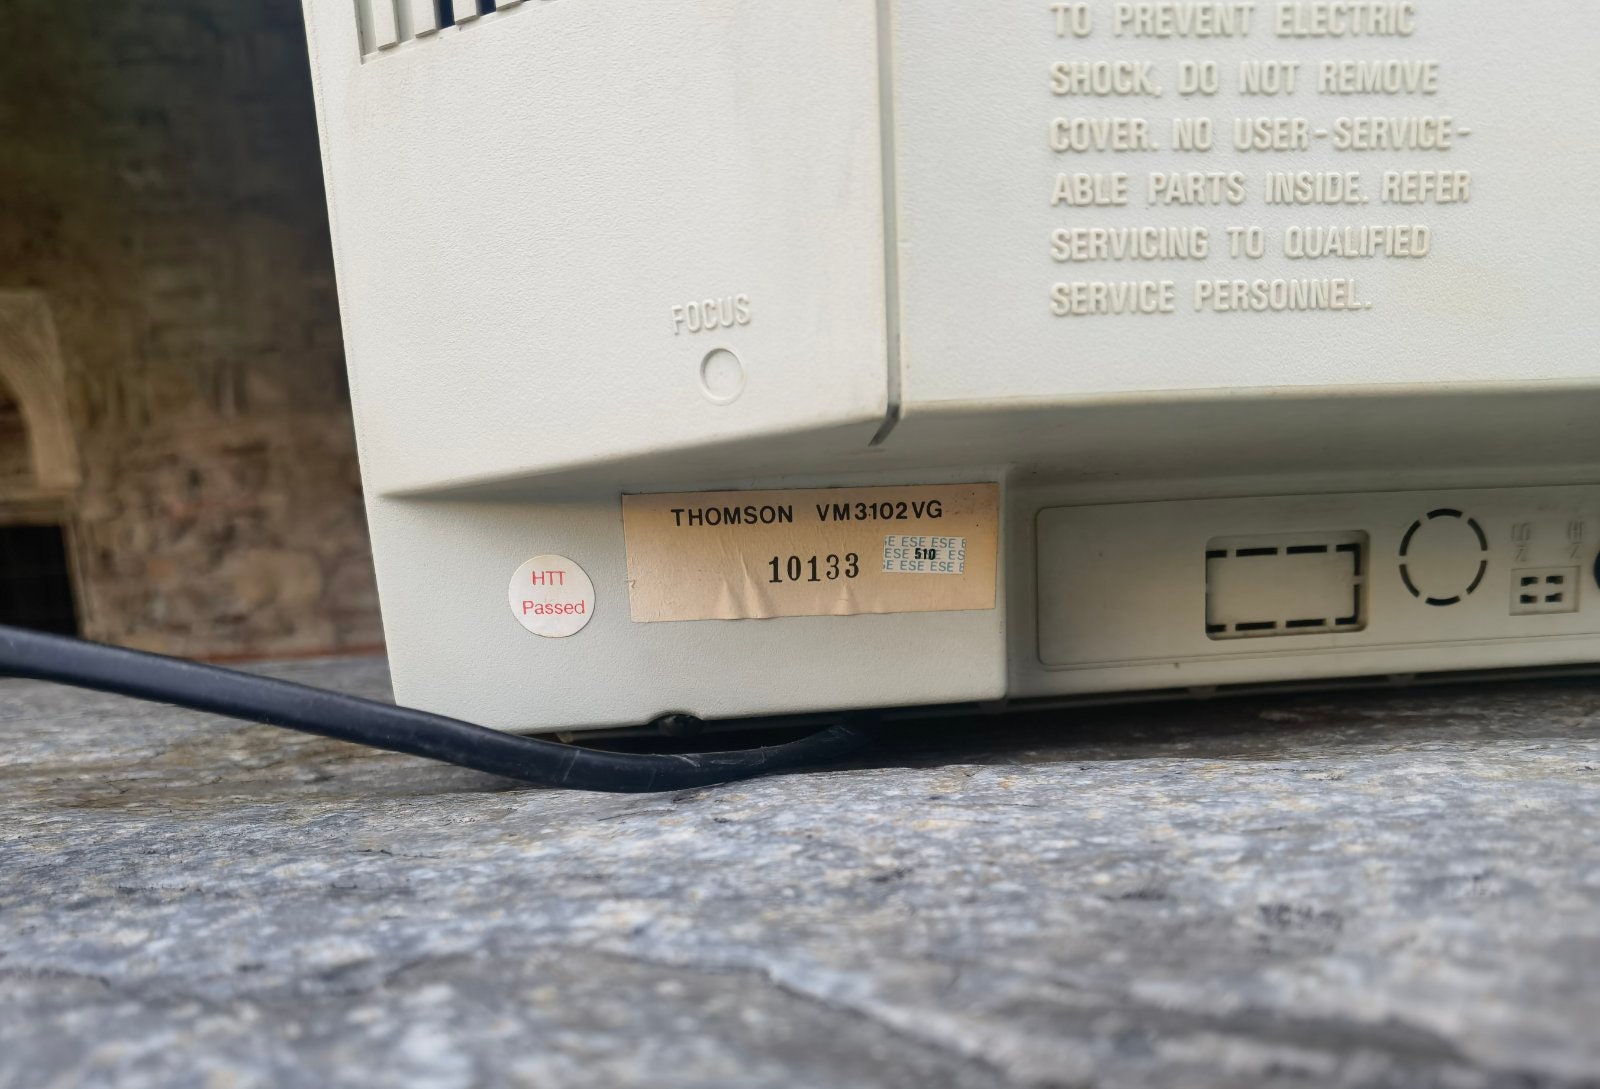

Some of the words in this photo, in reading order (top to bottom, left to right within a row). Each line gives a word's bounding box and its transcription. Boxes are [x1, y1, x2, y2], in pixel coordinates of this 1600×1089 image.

[1050, 2, 1092, 38] TO
[1113, 2, 1255, 38] PREVENT
[1274, 1, 1417, 38] ELECTRIC
[1177, 60, 1219, 95] DO
[1239, 60, 1300, 95] NOT
[1317, 59, 1439, 95] REMOVE
[1049, 117, 1160, 152] COVER.
[1172, 117, 1213, 151] NO
[1051, 172, 1129, 206] ABLE
[1148, 171, 1246, 206] PARTS
[1265, 170, 1369, 205] INSIDE.
[1381, 169, 1472, 204] REFER
[1049, 226, 1210, 263] SERVICING
[1226, 226, 1265, 260] TO
[1284, 224, 1431, 260] QUALIFIED
[671, 293, 751, 336] FOCUS
[1050, 280, 1175, 316] SERVICE
[1194, 278, 1373, 313] PERSONNEL.
[671, 505, 793, 527] THOMSON
[816, 500, 943, 522] VM3102VG
[768, 552, 860, 583] 10133
[914, 547, 937, 560] 510
[532, 570, 566, 586] HTT
[522, 599, 586, 616] Passed
